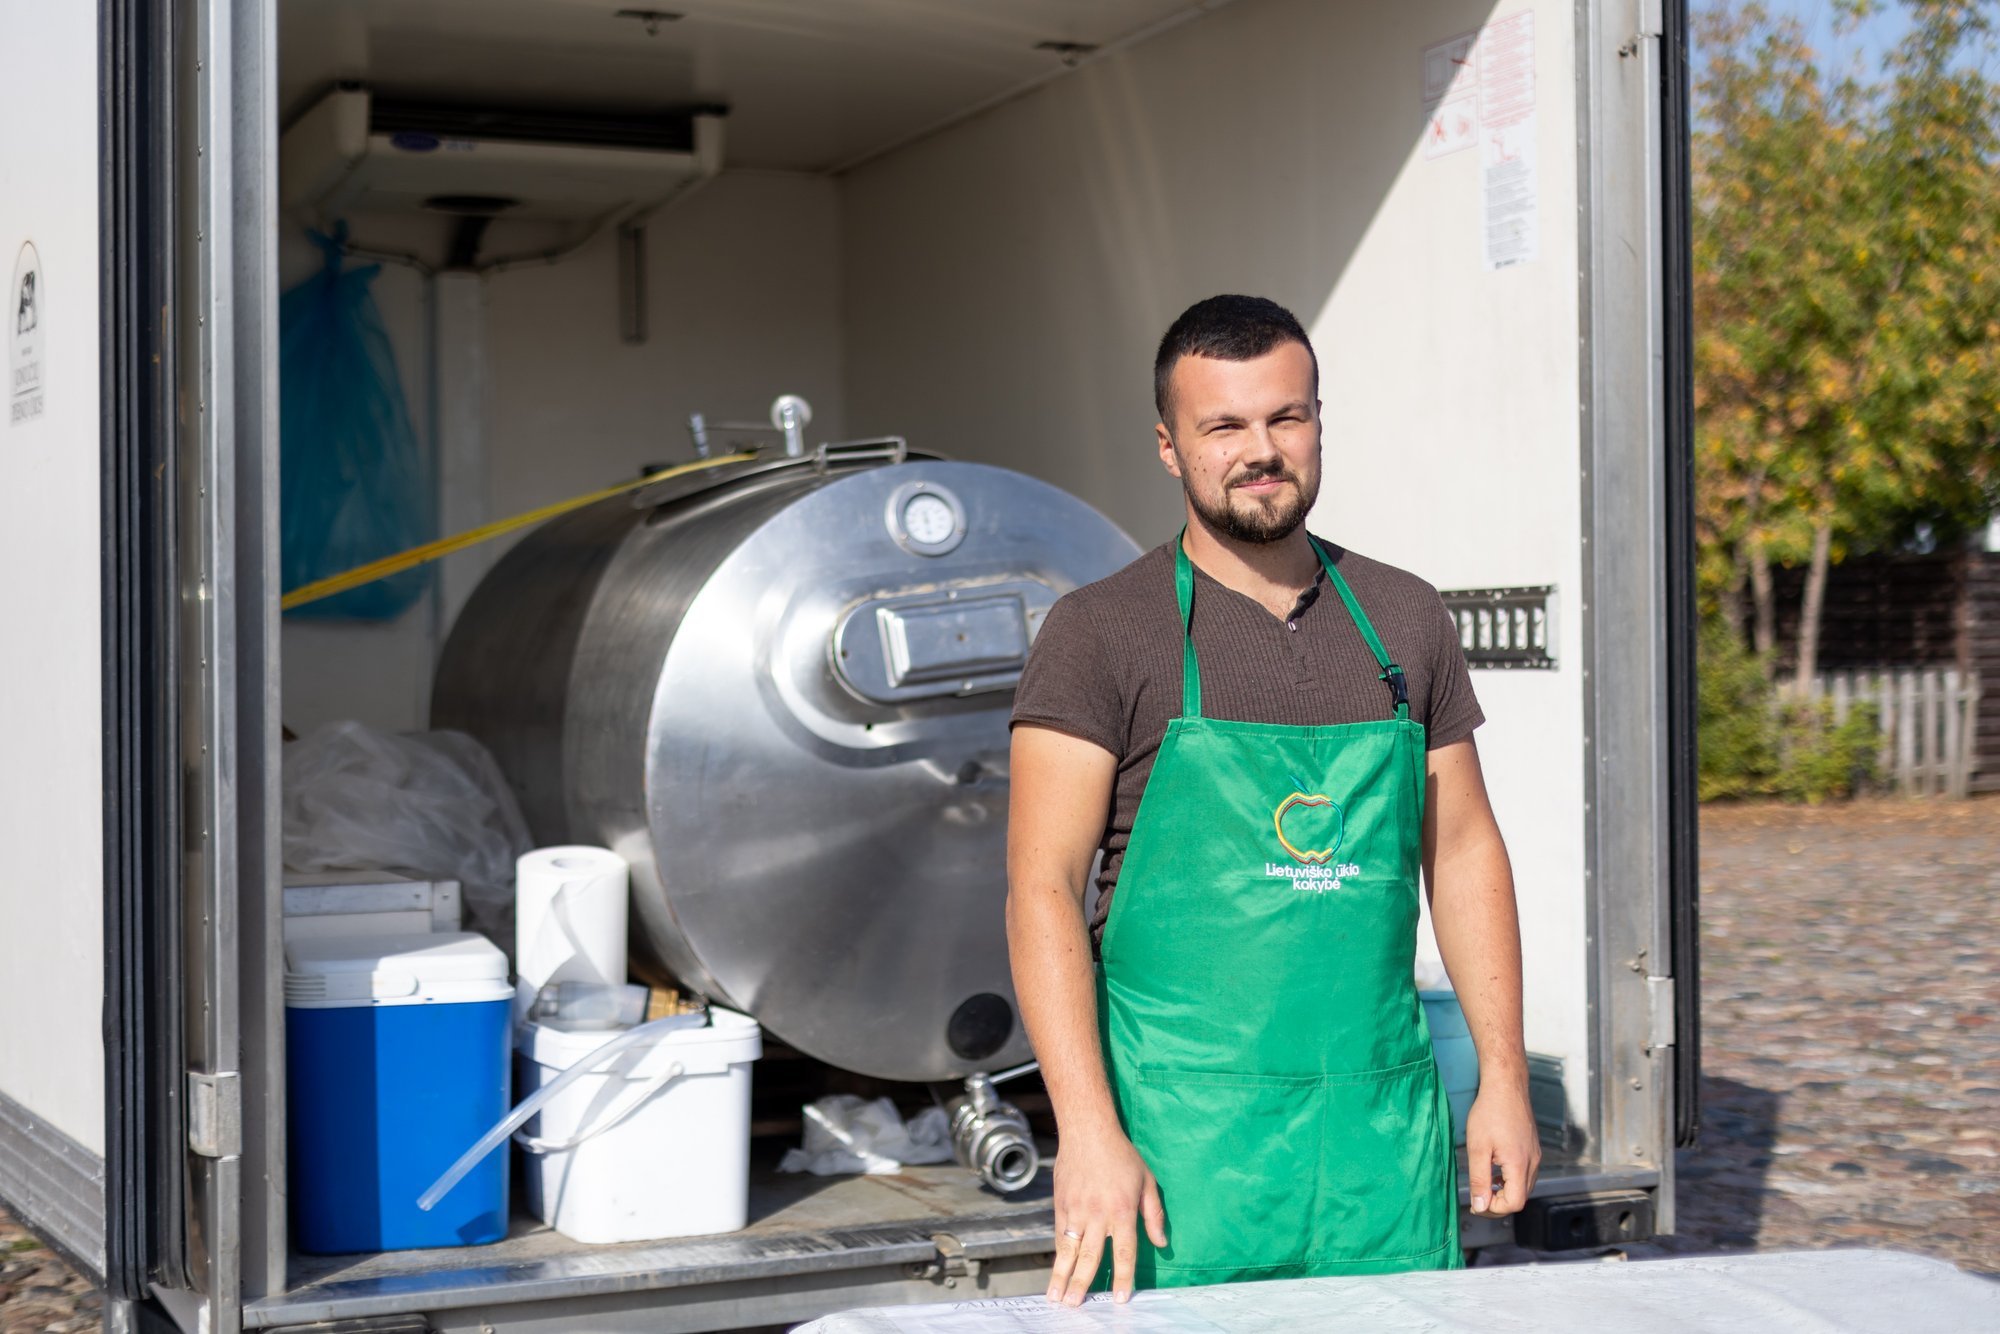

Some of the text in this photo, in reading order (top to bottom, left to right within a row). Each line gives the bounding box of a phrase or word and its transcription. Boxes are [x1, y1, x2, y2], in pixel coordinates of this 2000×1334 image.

[1265, 863, 1360, 878] Lietuviško ūkio
[1293, 877, 1341, 893] kokybė
